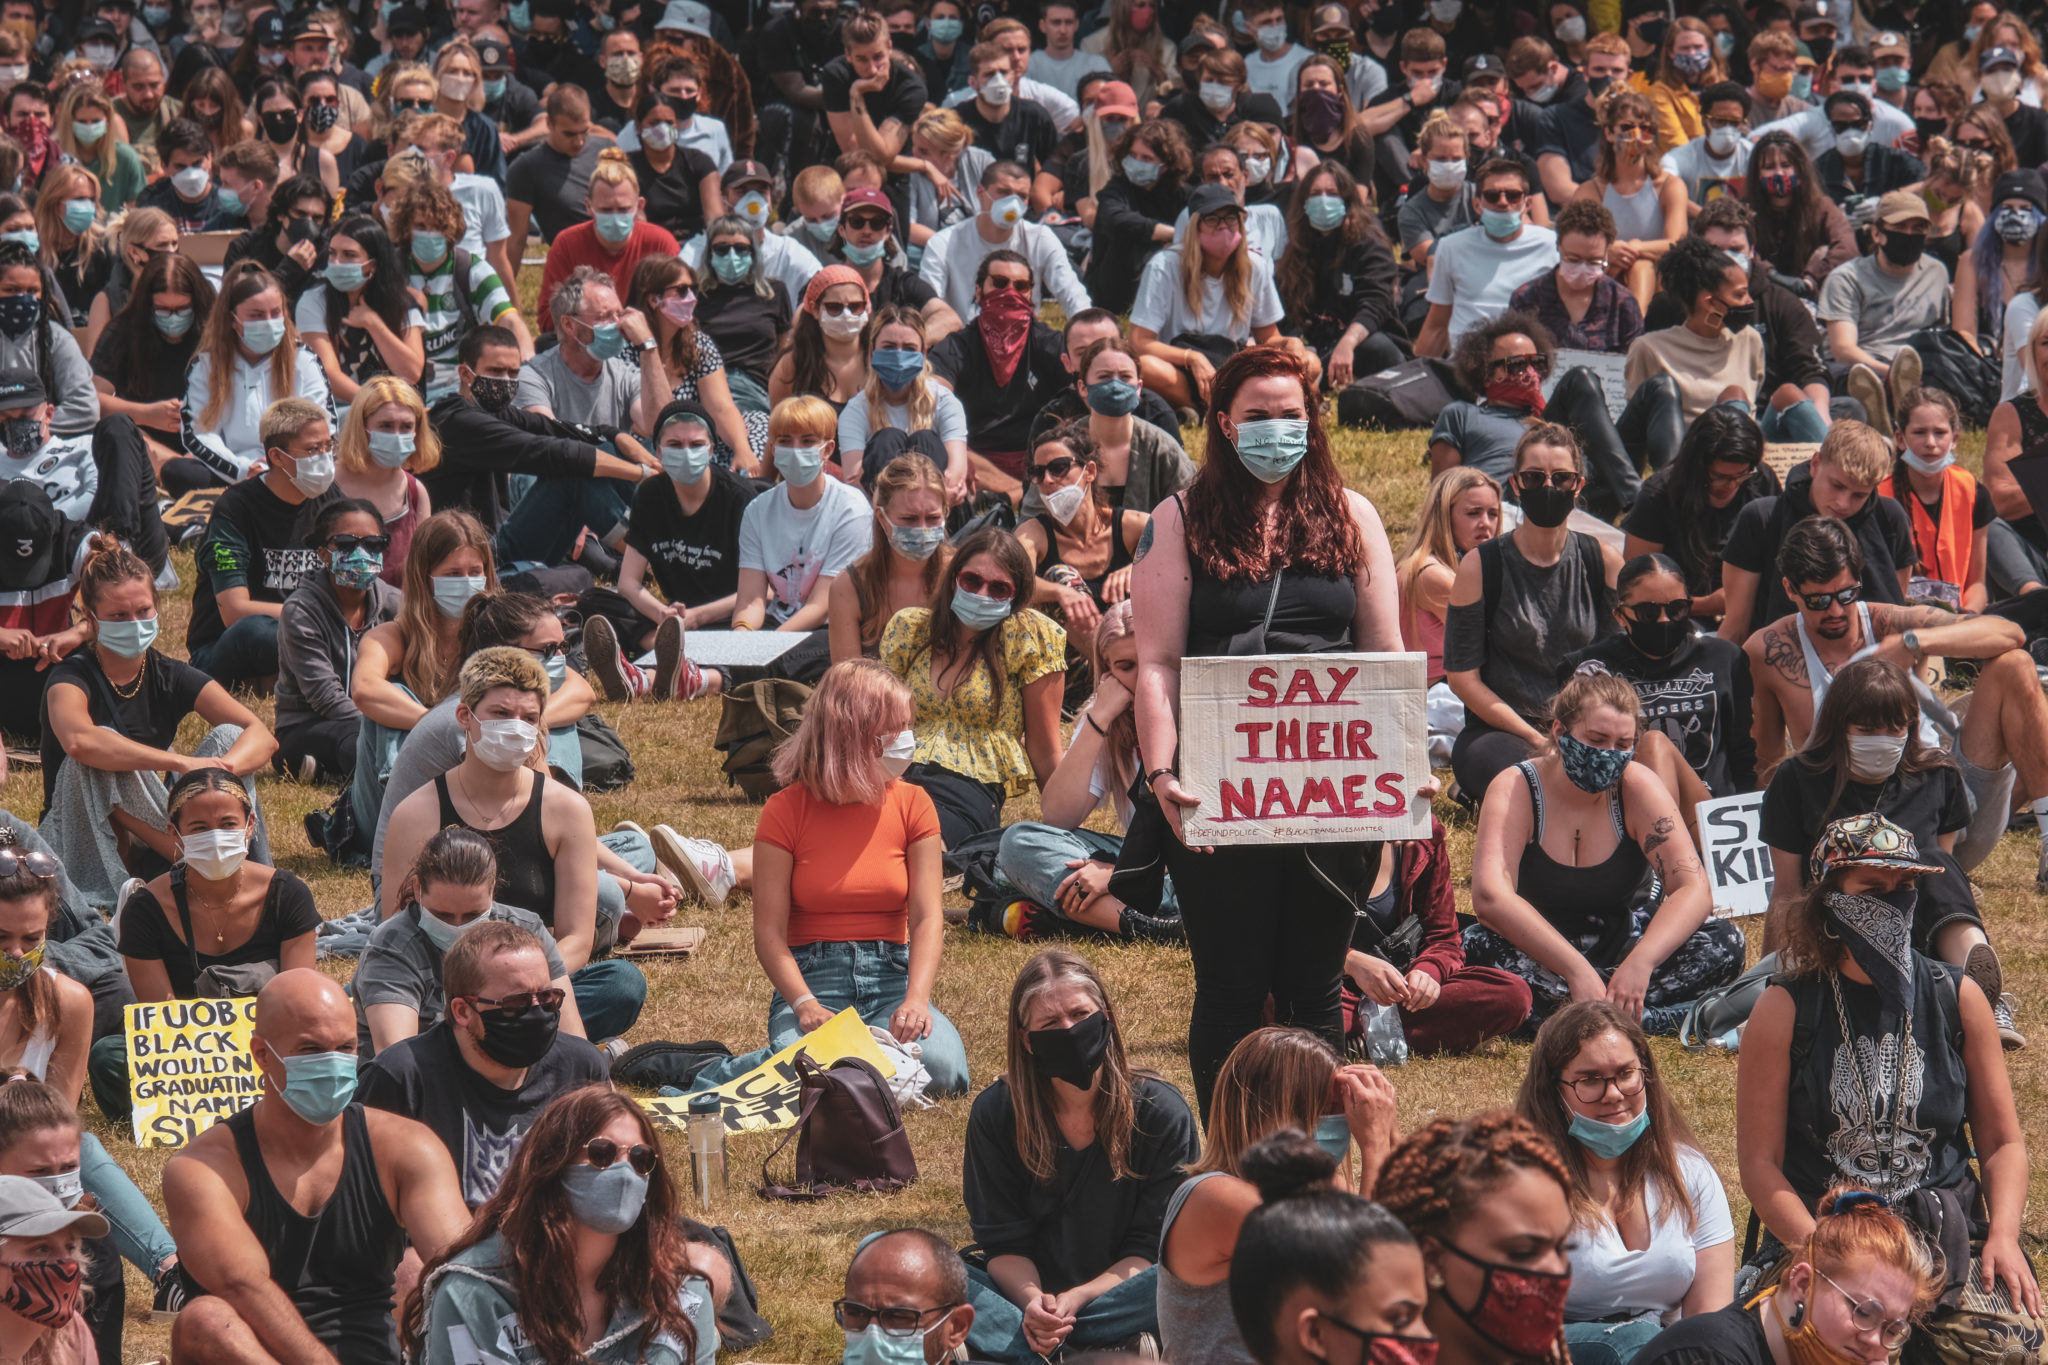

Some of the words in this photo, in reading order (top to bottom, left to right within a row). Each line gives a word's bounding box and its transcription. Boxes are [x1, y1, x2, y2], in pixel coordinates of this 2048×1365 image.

[16, 539, 33, 557] 3
[1247, 666, 1359, 706] SAY
[1635, 681, 1694, 696] AKLAND
[1638, 699, 1704, 717] AIDERS
[1234, 717, 1378, 761] THEIR
[1219, 773, 1406, 820] NAMES
[133, 1006, 157, 1031] IF
[162, 1000, 238, 1029] UOB
[133, 1031, 240, 1057] BLACK
